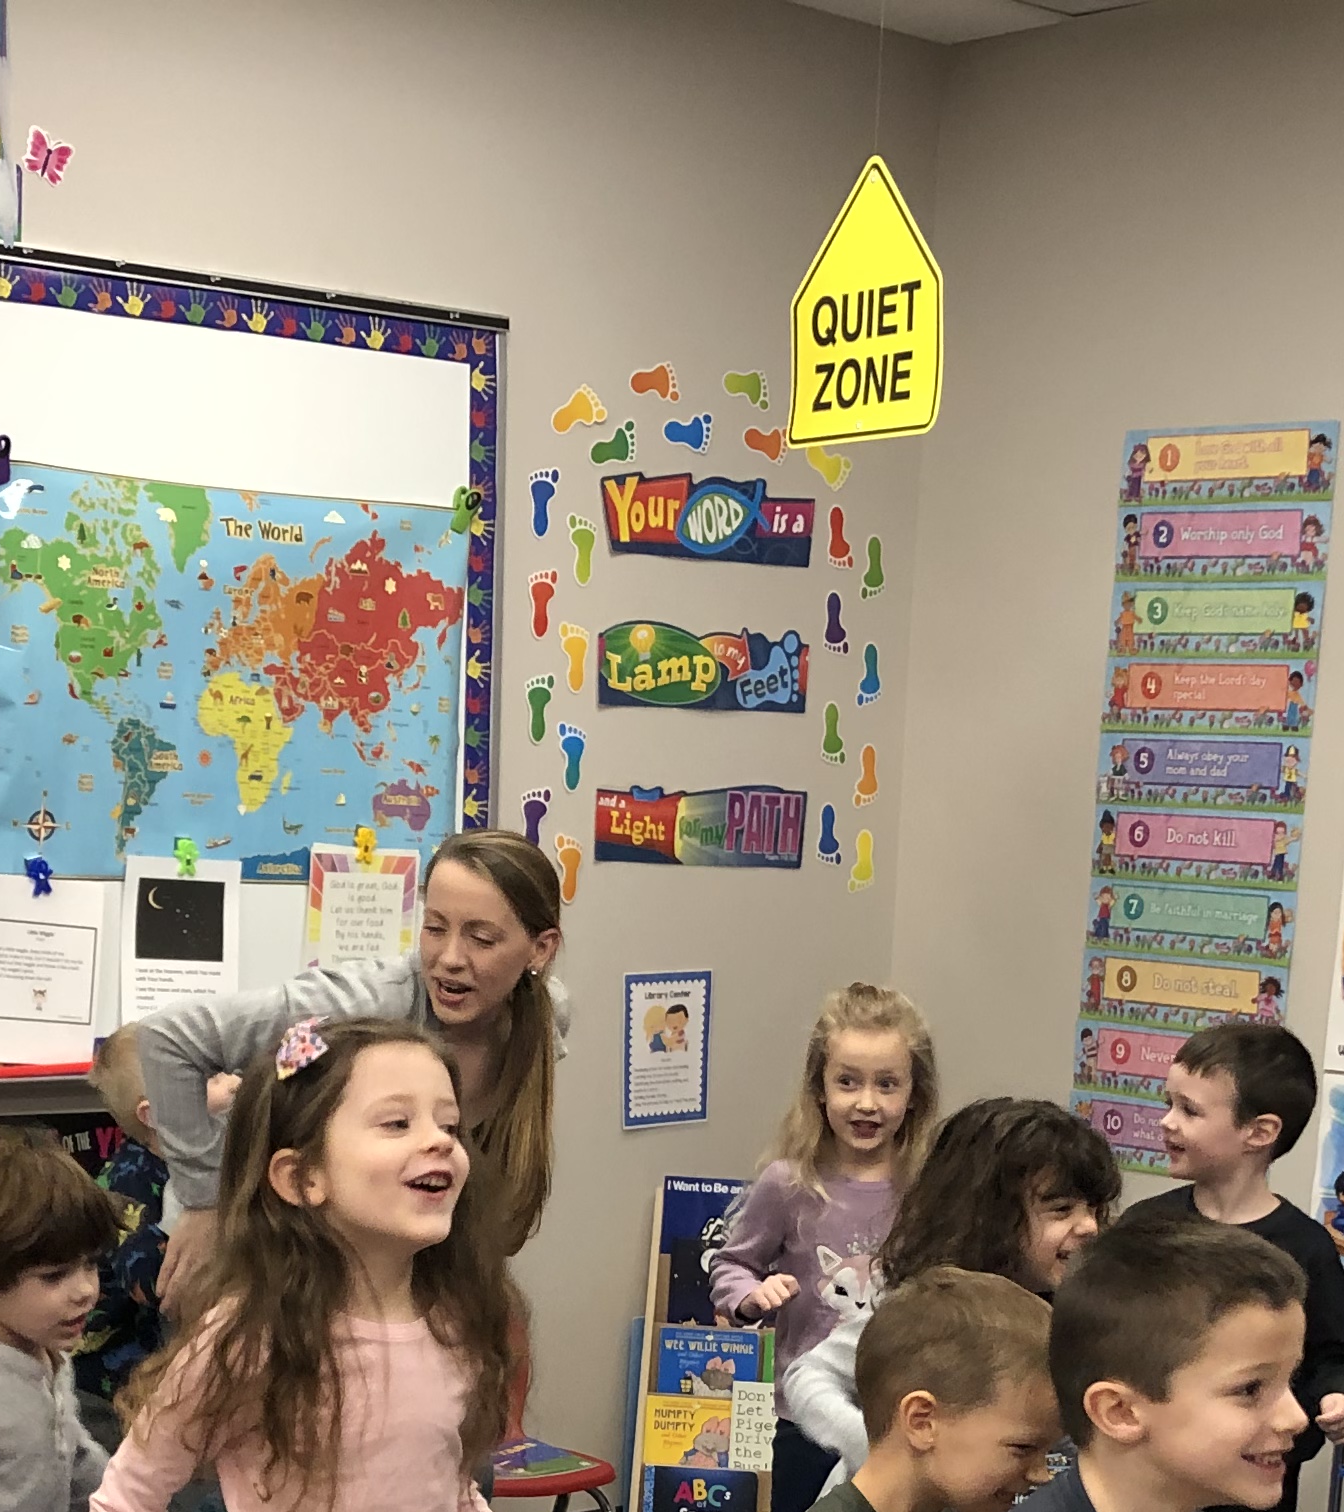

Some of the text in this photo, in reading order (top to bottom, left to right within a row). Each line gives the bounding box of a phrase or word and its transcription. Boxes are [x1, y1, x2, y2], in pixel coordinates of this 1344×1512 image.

[812, 279, 921, 347] QUIET
[812, 350, 913, 413] ZONE
[603, 476, 804, 545] Your WORD is a
[219, 517, 303, 543] The World
[1158, 521, 1284, 545] 2 Worship only God
[605, 647, 717, 696] Lamp
[725, 646, 746, 671] my
[739, 668, 789, 703] Feet
[597, 794, 626, 809] and a
[610, 810, 666, 845] Light
[698, 819, 727, 850] my
[725, 790, 803, 855] PATH
[1133, 826, 1238, 848] 6 Do not kill
[667, 1180, 671, 1190] I
[672, 1181, 700, 1192] Want
[701, 1183, 712, 1193] to
[713, 1184, 728, 1194] Be
[673, 1478, 731, 1508] ABCs
